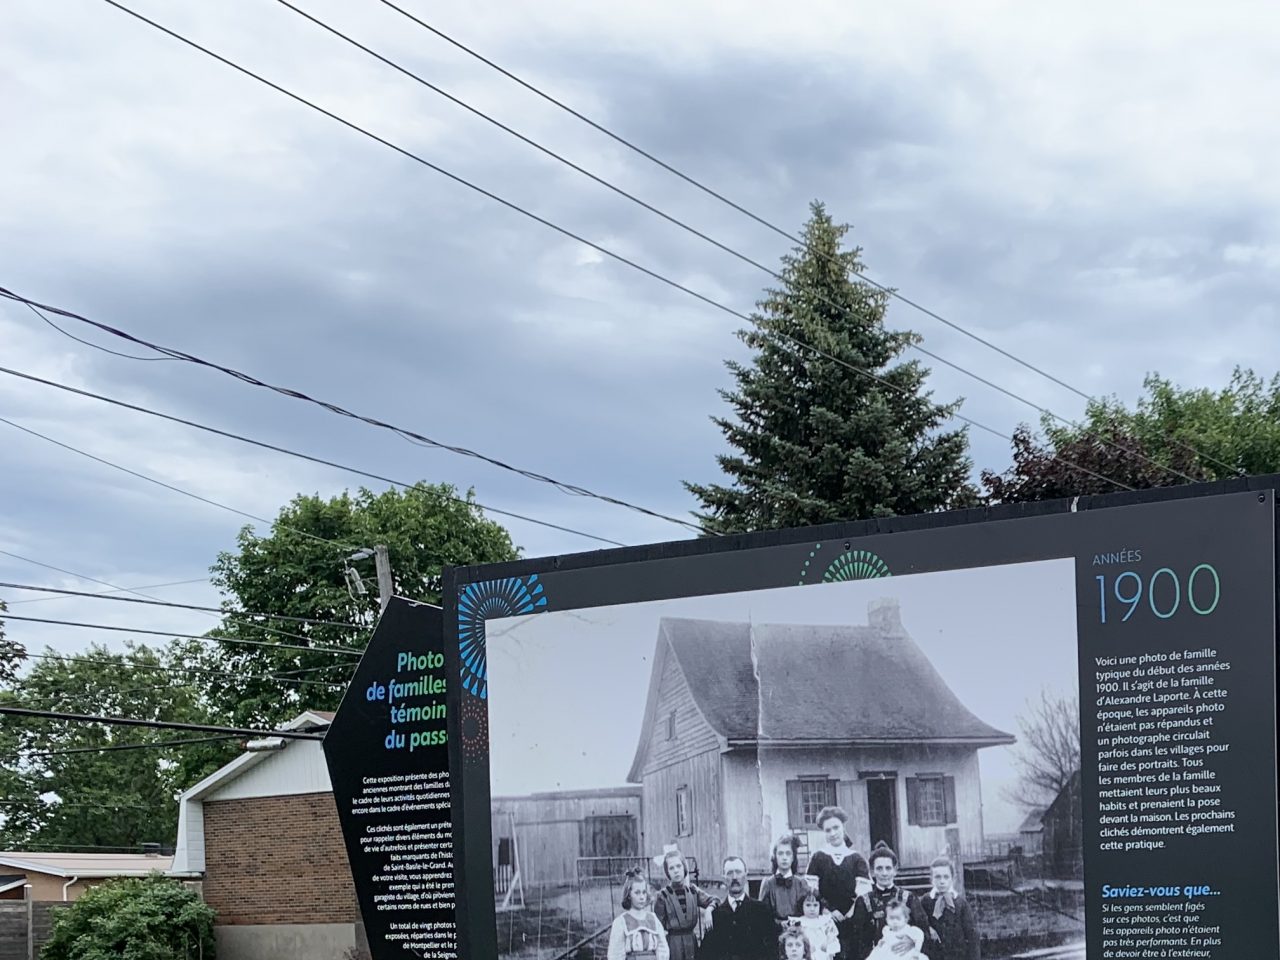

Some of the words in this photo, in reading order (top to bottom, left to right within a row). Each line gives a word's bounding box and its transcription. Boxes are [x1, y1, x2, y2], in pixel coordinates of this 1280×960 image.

[1092, 548, 1142, 565] ANNÉES
[1096, 564, 1220, 623] 1900
[398, 651, 444, 672] Photo
[1095, 655, 1117, 666] Voici
[1119, 656, 1137, 664] une
[1138, 651, 1167, 666] photo
[1169, 650, 1181, 661] de
[1183, 648, 1217, 660] famille
[1096, 667, 1131, 682] typique
[1132, 666, 1145, 676] du
[1147, 664, 1175, 676] début
[1177, 663, 1194, 673] des
[1196, 660, 1231, 672] années
[366, 682, 385, 701] de
[1096, 681, 1120, 692] 1900.
[1122, 681, 1129, 691] Il
[1131, 679, 1154, 693] s'agit
[1156, 678, 1168, 688] de
[1170, 677, 1179, 688] la
[1180, 675, 1215, 687] famille
[1097, 693, 1150, 706] d'Alexandre
[1153, 690, 1191, 705] Laporte.
[1193, 687, 1201, 699] À
[1202, 688, 1228, 699] cette
[391, 700, 446, 723] témoin
[1097, 707, 1133, 721] époque,
[1135, 706, 1149, 716] les
[1150, 703, 1194, 718] appareils
[1196, 701, 1225, 715] photo
[1098, 720, 1137, 732] n'étaient
[1139, 721, 1155, 732] pas
[1157, 716, 1201, 731] répandus
[1202, 715, 1214, 726] et
[385, 730, 405, 749] du
[410, 729, 448, 752] pass
[1098, 737, 1110, 745] un
[1111, 731, 1171, 747] photographe
[1172, 729, 1211, 741] circulait
[1098, 747, 1129, 761] parfois
[1130, 746, 1152, 756] dans
[1154, 745, 1168, 755] les
[1170, 743, 1205, 757] villages
[1206, 744, 1230, 755] pour
[1099, 761, 1118, 771] faire
[1120, 760, 1136, 770] des
[1138, 758, 1179, 772] portraits.
[1181, 757, 1204, 767] Tous
[1099, 774, 1112, 784] les
[1113, 772, 1156, 784] membres
[1158, 771, 1170, 782] de
[1172, 771, 1181, 781] la
[1182, 769, 1216, 780] famille
[1099, 786, 1144, 798] mettaient
[1145, 785, 1168, 796] leurs
[1170, 784, 1190, 797] plus
[1192, 782, 1222, 793] beaux
[1100, 800, 1126, 810] habits
[1128, 799, 1138, 809] et
[1140, 798, 1185, 812] prenaient
[1187, 797, 1196, 807] la
[1197, 798, 1221, 809] pose
[1100, 813, 1128, 824] devant
[1130, 812, 1138, 822] la
[1139, 811, 1172, 822] maison.
[1174, 810, 1190, 821] Les
[1191, 809, 1236, 823] prochains
[1100, 826, 1130, 837] clichés
[1131, 824, 1184, 836] démontrent
[1186, 822, 1235, 836] également
[1100, 839, 1124, 850] cette
[1125, 838, 1166, 851] pratique.
[1102, 885, 1180, 898] Saviez-vous
[1184, 885, 1221, 899] que...
[1102, 904, 1109, 912] Si
[1110, 903, 1122, 912] les
[1123, 905, 1143, 914] gens
[1145, 902, 1183, 911] semblent
[1185, 902, 1207, 913] figés
[1162, 914, 1181, 922] c'est
[1183, 915, 1201, 924] que
[1104, 926, 1114, 935] les
[1116, 926, 1154, 937] appareils
[1155, 926, 1180, 936] photo
[1182, 925, 1221, 934] n'étaient
[1104, 940, 1118, 949] pas
[1119, 938, 1134, 946] très
[1190, 936, 1202, 945] En
[1203, 936, 1223, 947] plus
[1104, 949, 1113, 958] de
[1115, 949, 1140, 957] devoir
[1142, 949, 1159, 957] être
[1160, 949, 1166, 957] à
[1168, 948, 1212, 958] l'extérieur,
